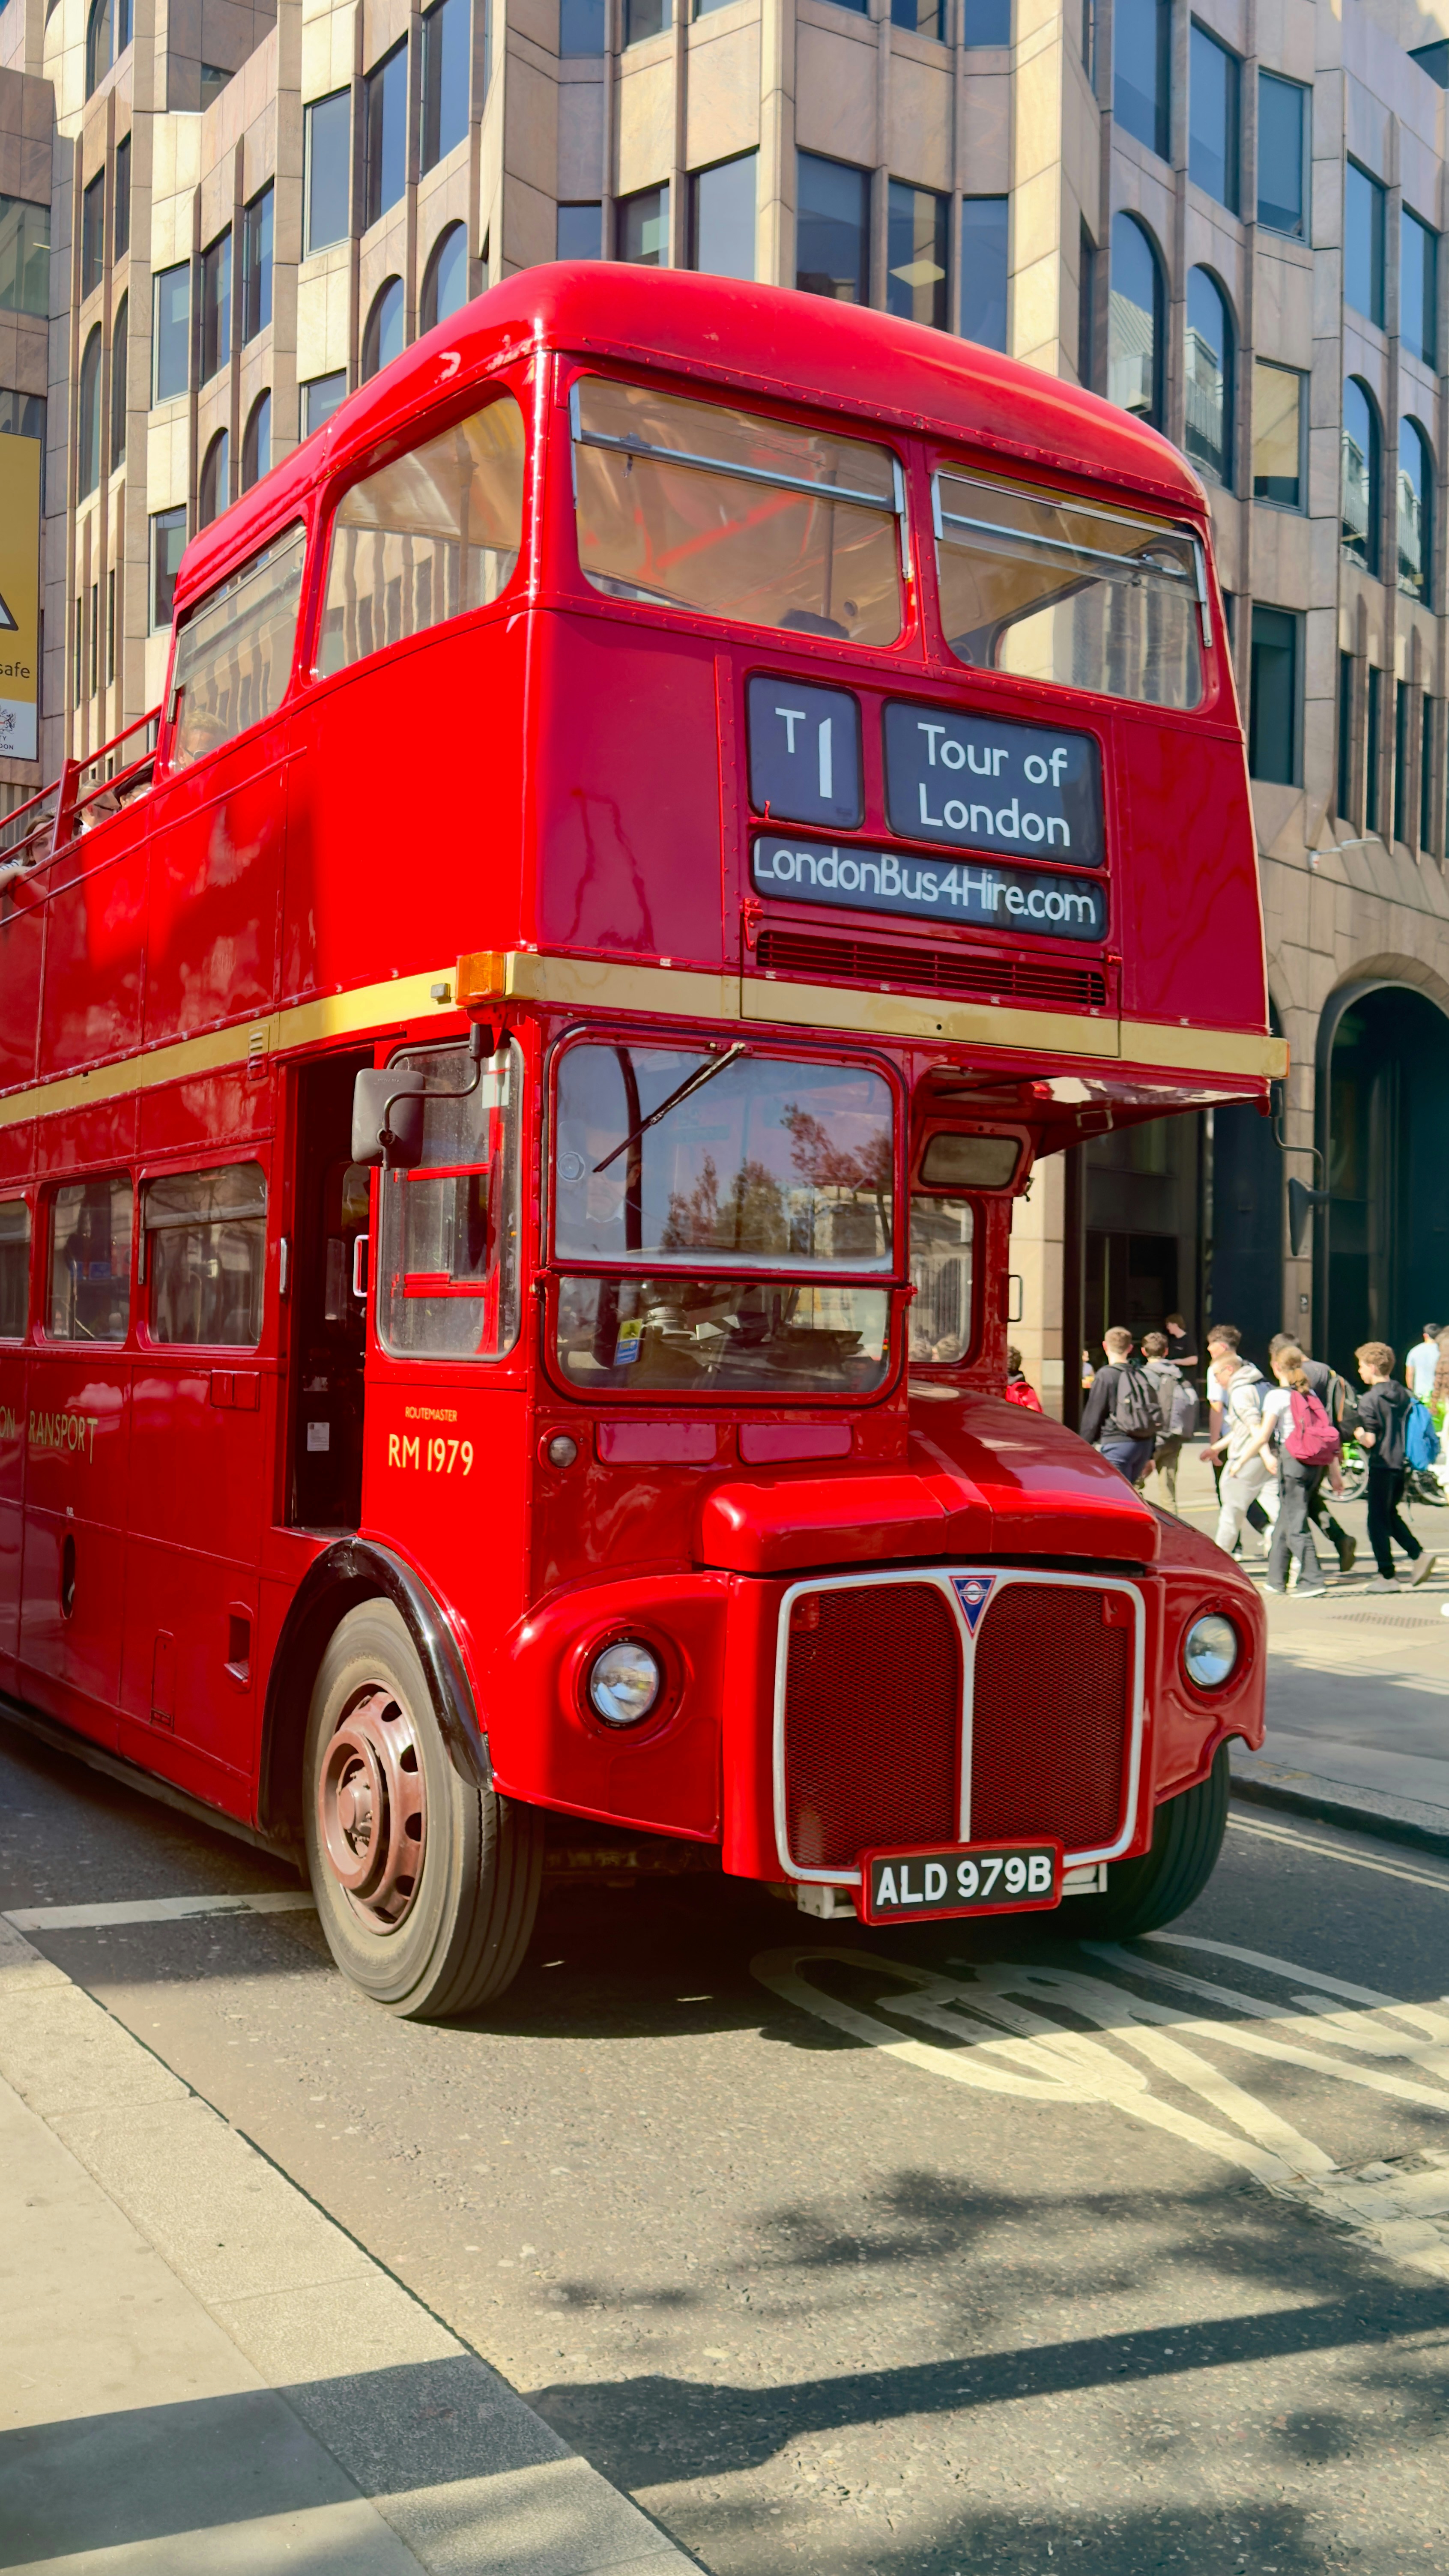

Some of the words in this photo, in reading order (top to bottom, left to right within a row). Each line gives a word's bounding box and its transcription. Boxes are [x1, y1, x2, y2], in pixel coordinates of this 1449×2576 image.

[917, 722, 1008, 777] Tour
[1024, 748, 1068, 787] of
[919, 783, 1070, 846] London
[754, 837, 1096, 924] LondonBus4Hire.com
[405, 1406, 457, 1422] ROUTEMASTER
[388, 1434, 419, 1470] RM
[427, 1437, 474, 1476] 1979
[876, 1863, 948, 1906] ALD
[956, 1856, 1052, 1898] 979B
